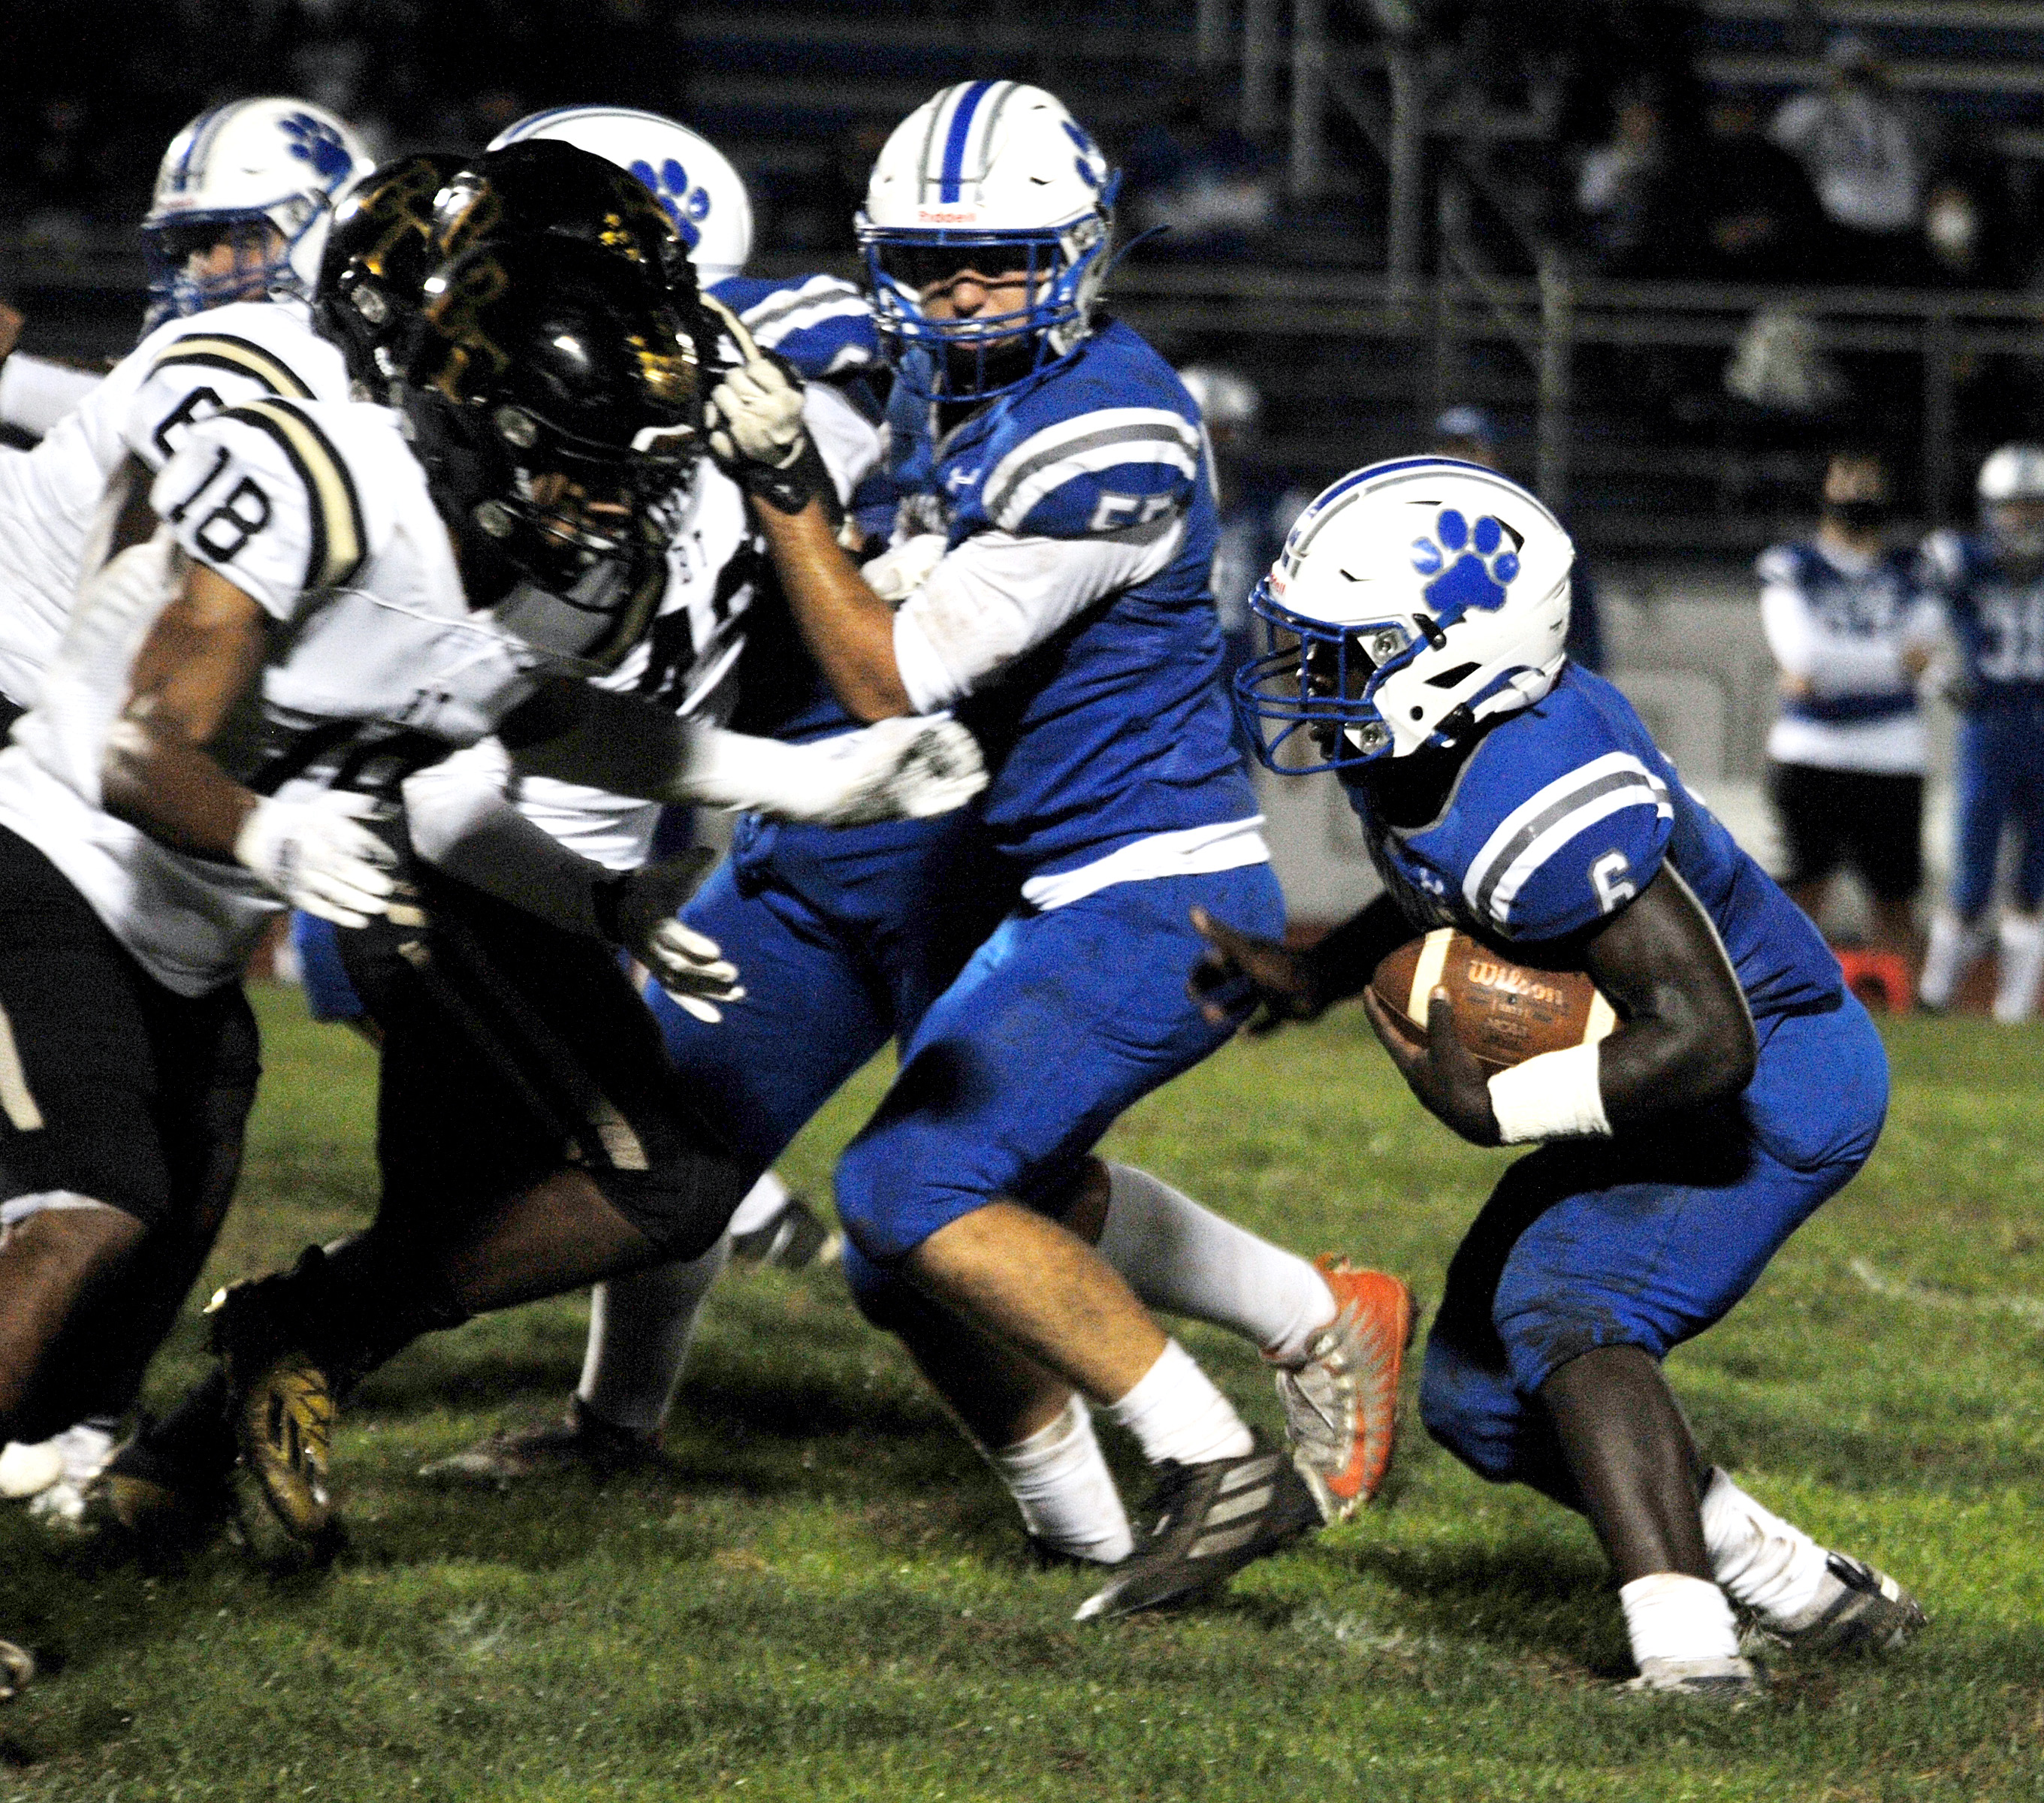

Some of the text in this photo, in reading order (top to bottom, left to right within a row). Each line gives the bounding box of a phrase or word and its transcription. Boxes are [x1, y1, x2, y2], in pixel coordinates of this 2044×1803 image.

[168, 445, 272, 563] 18
[1590, 850, 1636, 915] 6
[1469, 960, 1563, 1006] Wilson
